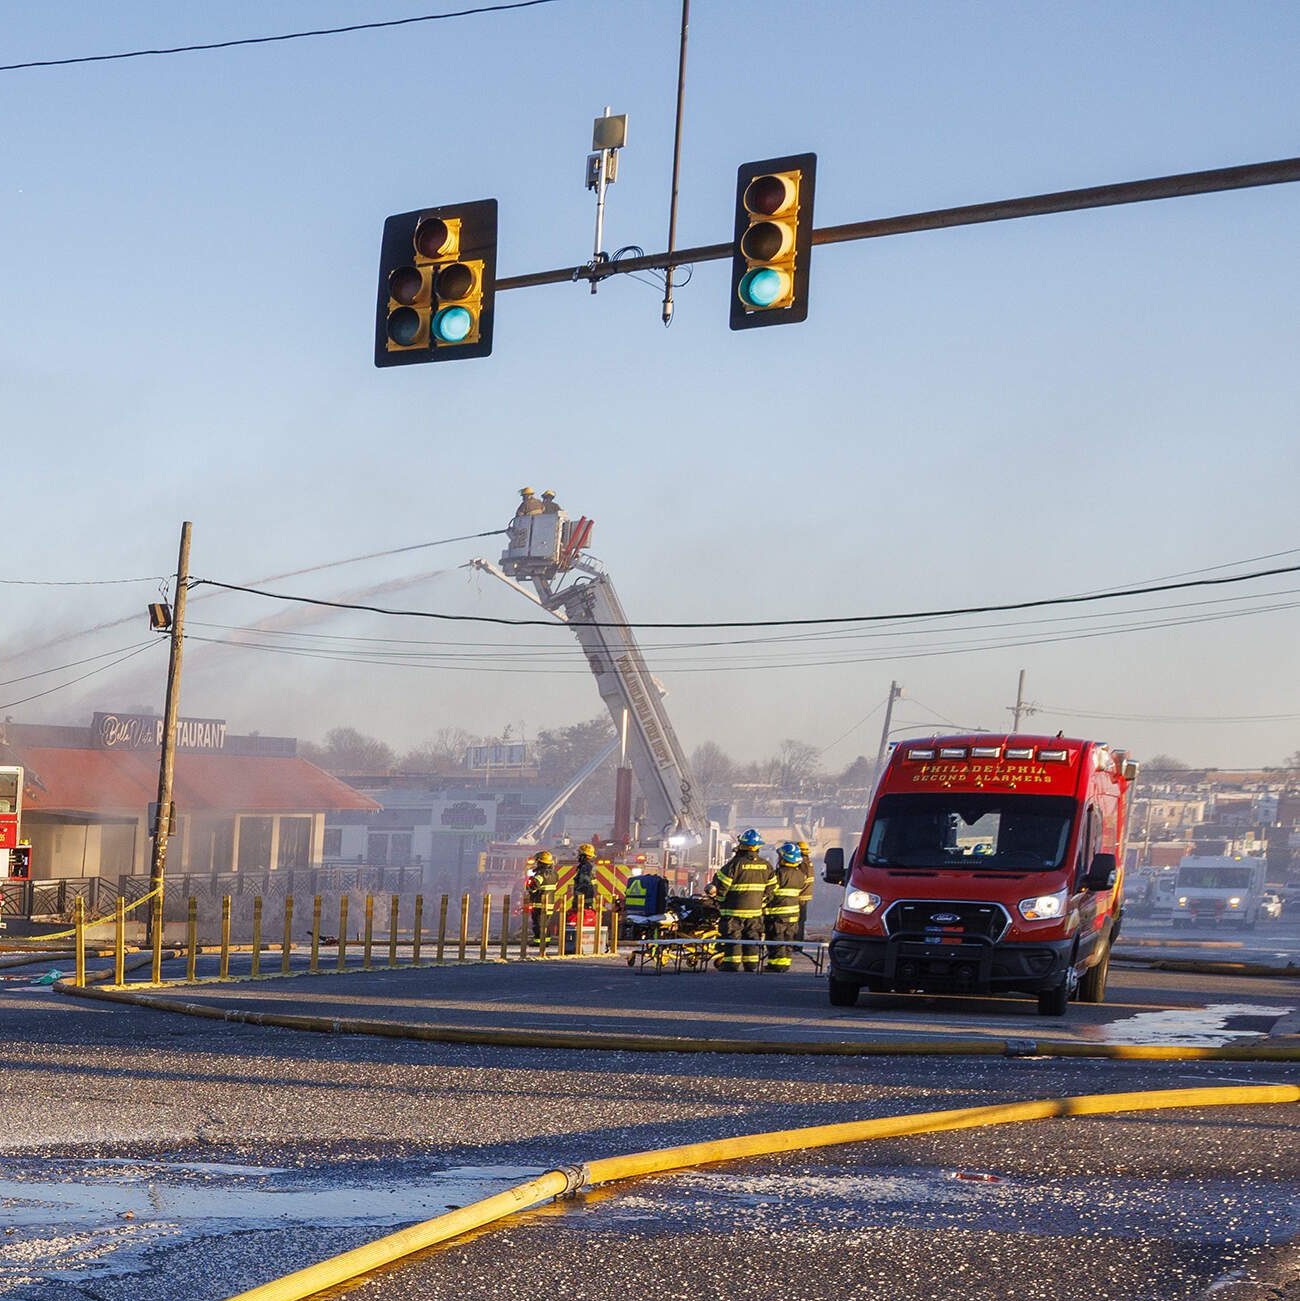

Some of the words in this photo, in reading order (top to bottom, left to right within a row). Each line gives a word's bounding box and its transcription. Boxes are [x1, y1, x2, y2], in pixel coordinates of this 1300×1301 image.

[156, 719, 226, 748] RTAURANT
[920, 765, 1048, 775] PHILADELPHIA
[912, 774, 967, 782] SECOND
[974, 774, 1052, 783] ALARMERS
